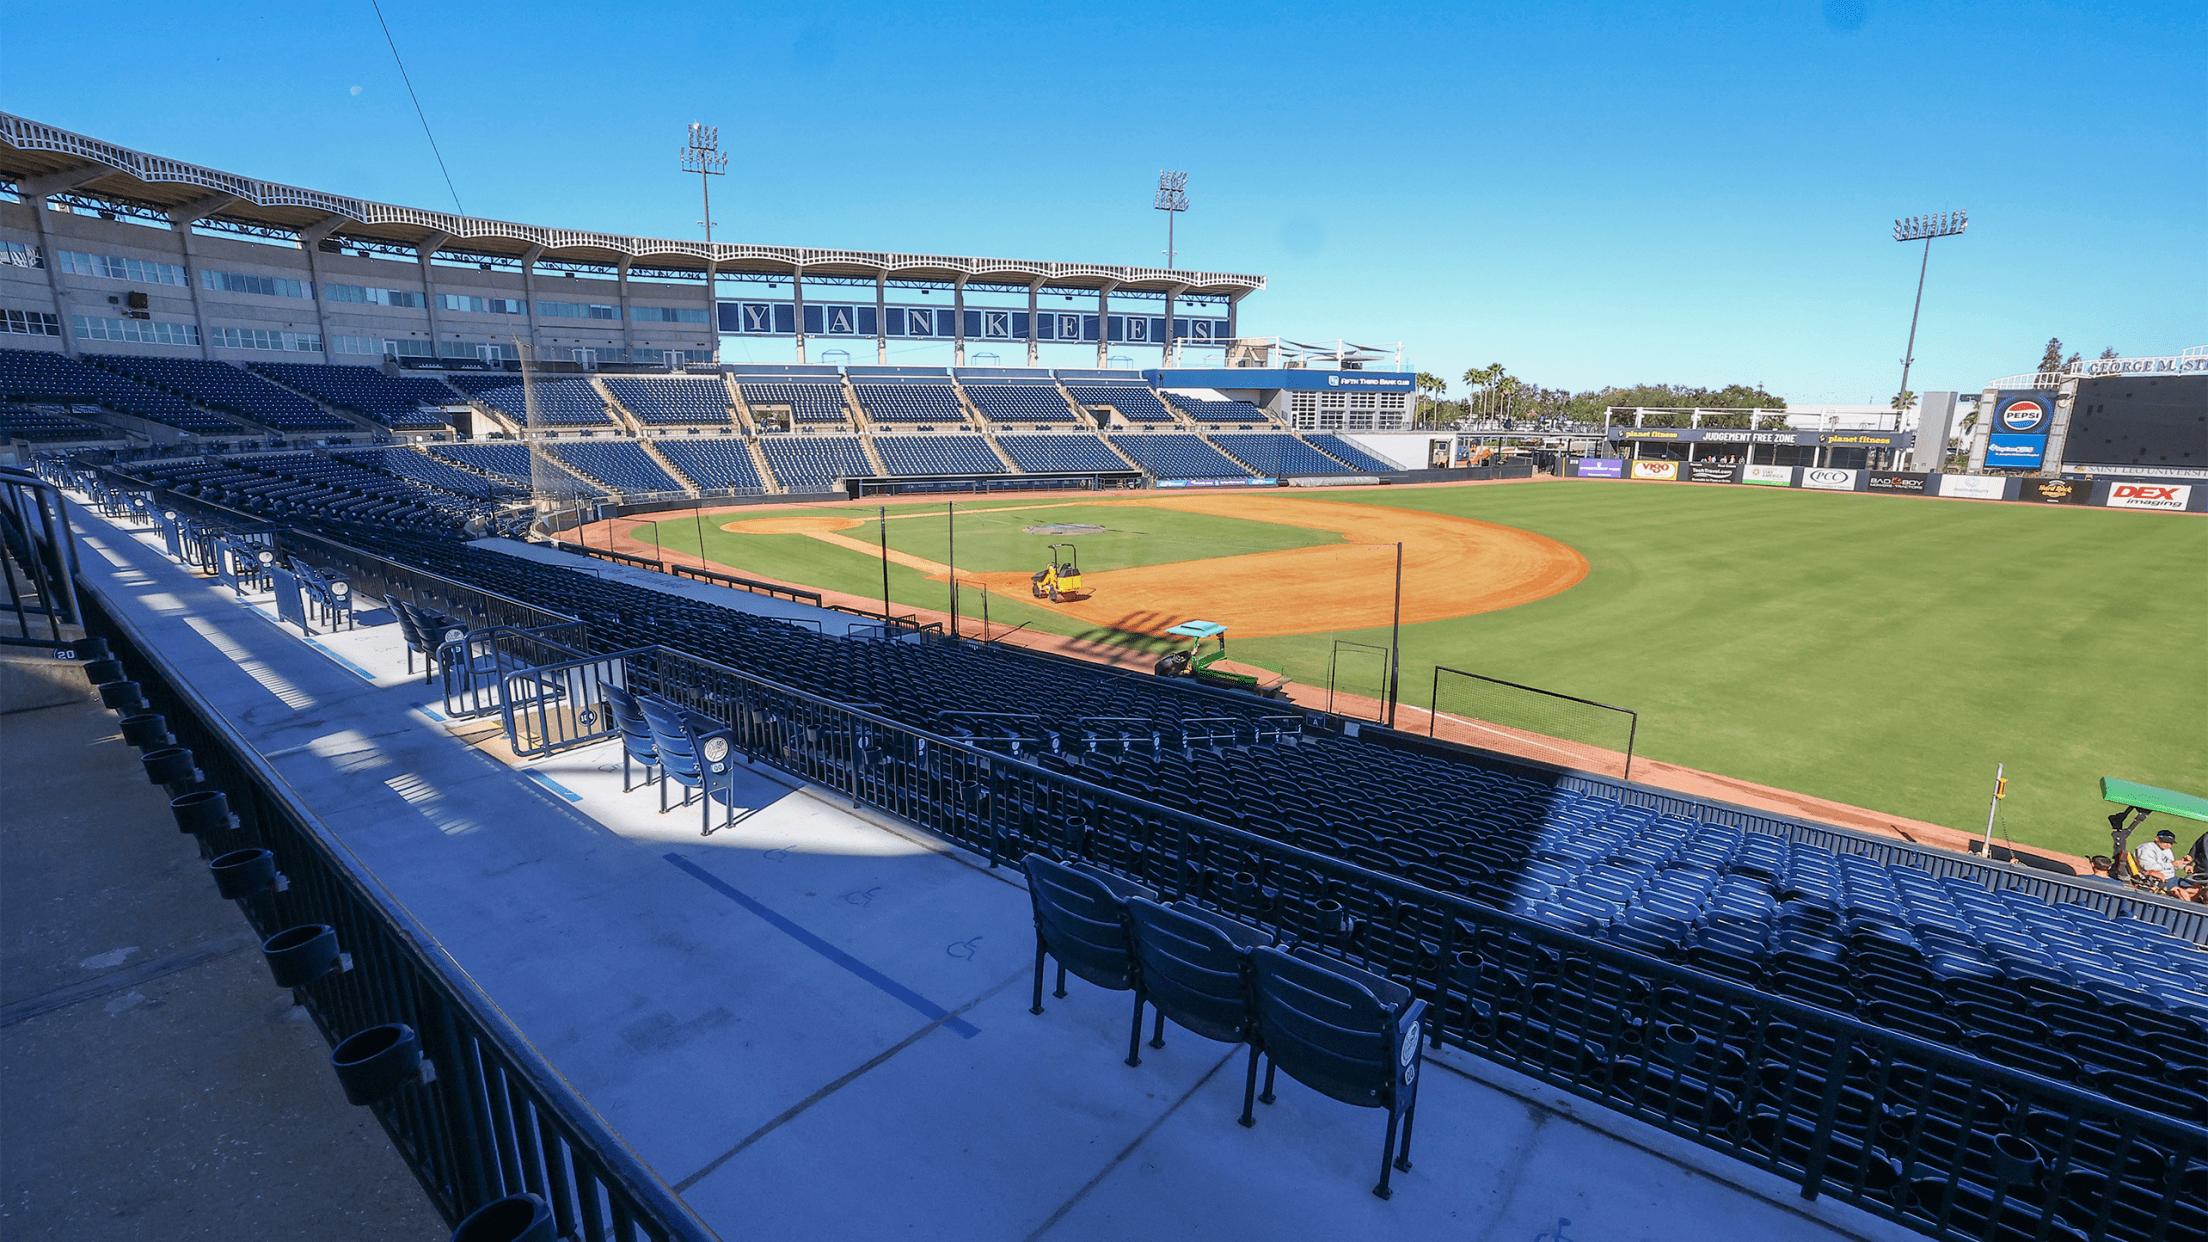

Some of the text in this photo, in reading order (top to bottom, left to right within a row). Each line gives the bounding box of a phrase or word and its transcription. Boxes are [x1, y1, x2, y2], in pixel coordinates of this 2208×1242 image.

[743, 305, 1208, 343] YANKEES
[2088, 360, 2153, 374] GEORGE
[2183, 359, 2208, 371] ST
[1380, 378, 1397, 386] BANK
[1625, 430, 1678, 439] planet fitness
[1702, 432, 1798, 443] JUDGEMENT FREE ZONE
[1827, 435, 1891, 444] planet fitness
[1816, 471, 1842, 481] PCC
[1901, 479, 1924, 487] BOY
[2112, 485, 2181, 500] DEX
[2126, 498, 2183, 508] imaging
[57, 649, 76, 659] 20
